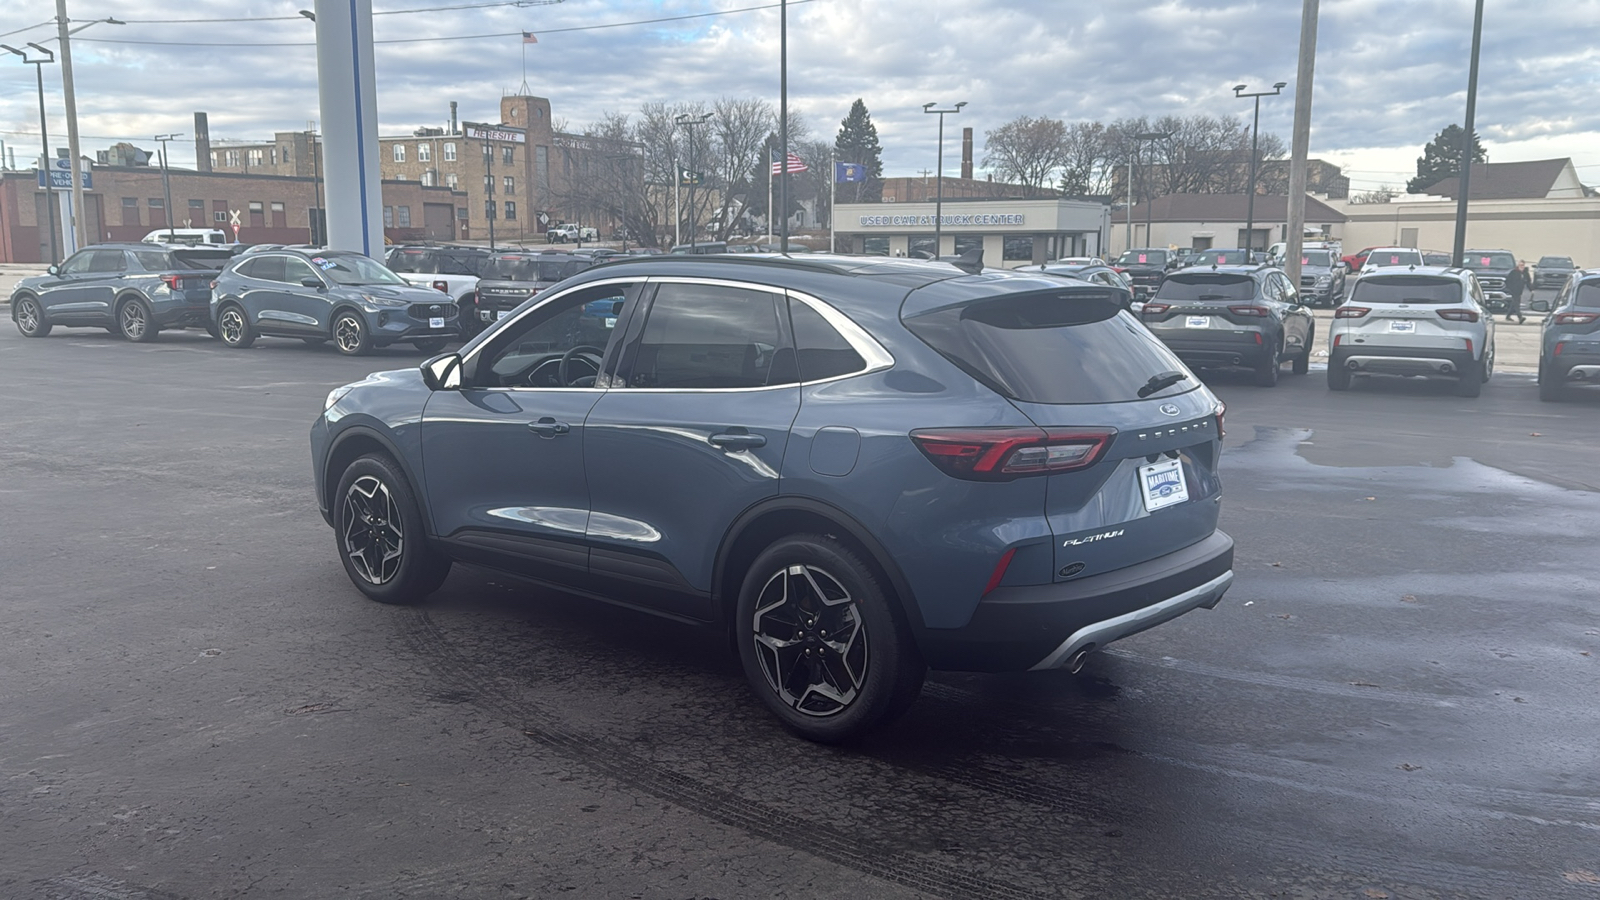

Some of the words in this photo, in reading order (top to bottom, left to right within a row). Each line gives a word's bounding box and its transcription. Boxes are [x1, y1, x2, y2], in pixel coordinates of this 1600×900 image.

[860, 215, 889, 226] USED
[893, 215, 917, 225] CAR
[920, 215, 927, 225] &
[931, 214, 970, 225] TRUCK
[974, 214, 1023, 225] CENTER
[1147, 470, 1180, 490] MARITIME
[1063, 529, 1124, 548] PLATINUM
